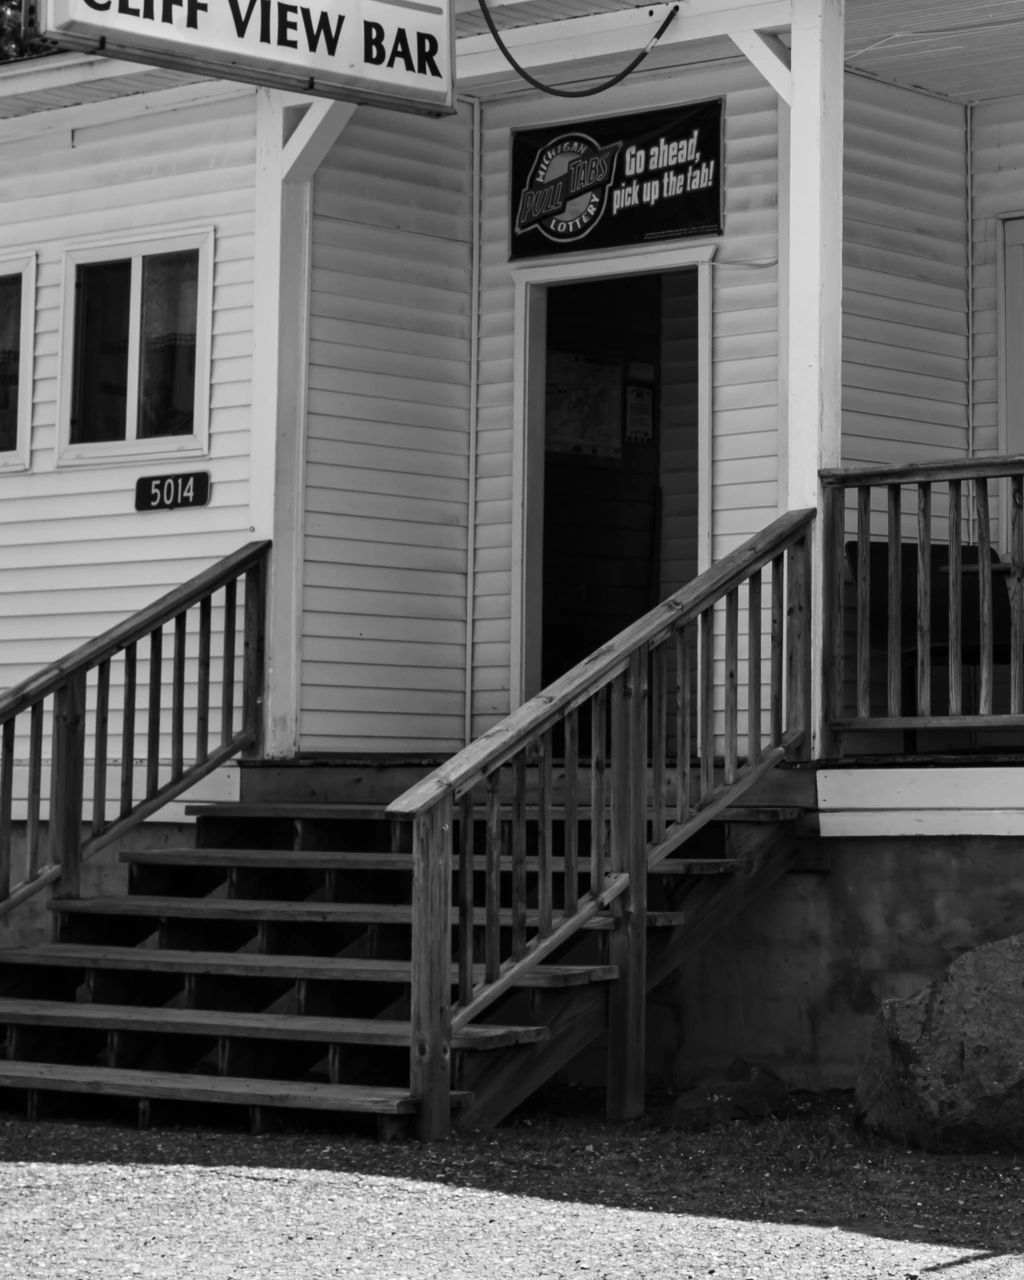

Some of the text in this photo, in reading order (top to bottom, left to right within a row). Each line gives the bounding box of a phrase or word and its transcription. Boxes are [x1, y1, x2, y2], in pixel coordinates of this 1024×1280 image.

[363, 20, 443, 78] BAR
[536, 141, 588, 183] MICHIGAN
[625, 130, 700, 176] Go ahead,
[520, 151, 612, 224] PULL TABS
[613, 160, 715, 215] pick up the tab!
[549, 193, 600, 233] LOTTERY
[150, 476, 194, 506] 5014
